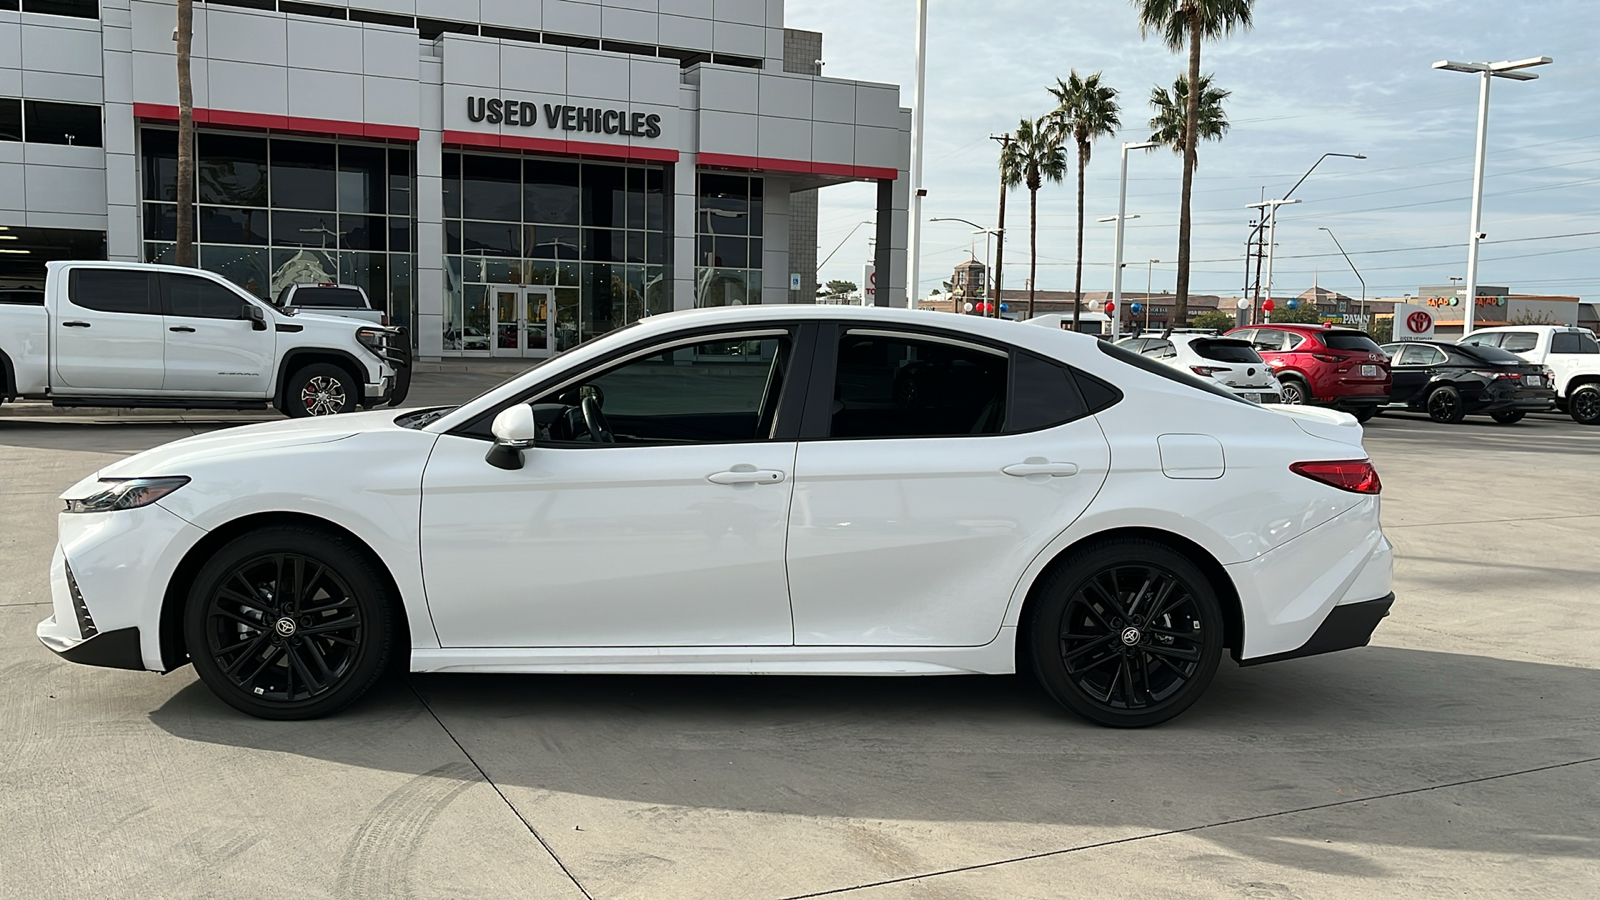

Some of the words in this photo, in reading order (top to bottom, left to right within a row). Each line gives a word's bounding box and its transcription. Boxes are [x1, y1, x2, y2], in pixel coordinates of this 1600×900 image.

[467, 96, 538, 127] USED
[544, 104, 661, 138] VEHICLES
[1342, 314, 1371, 325] PAWN
